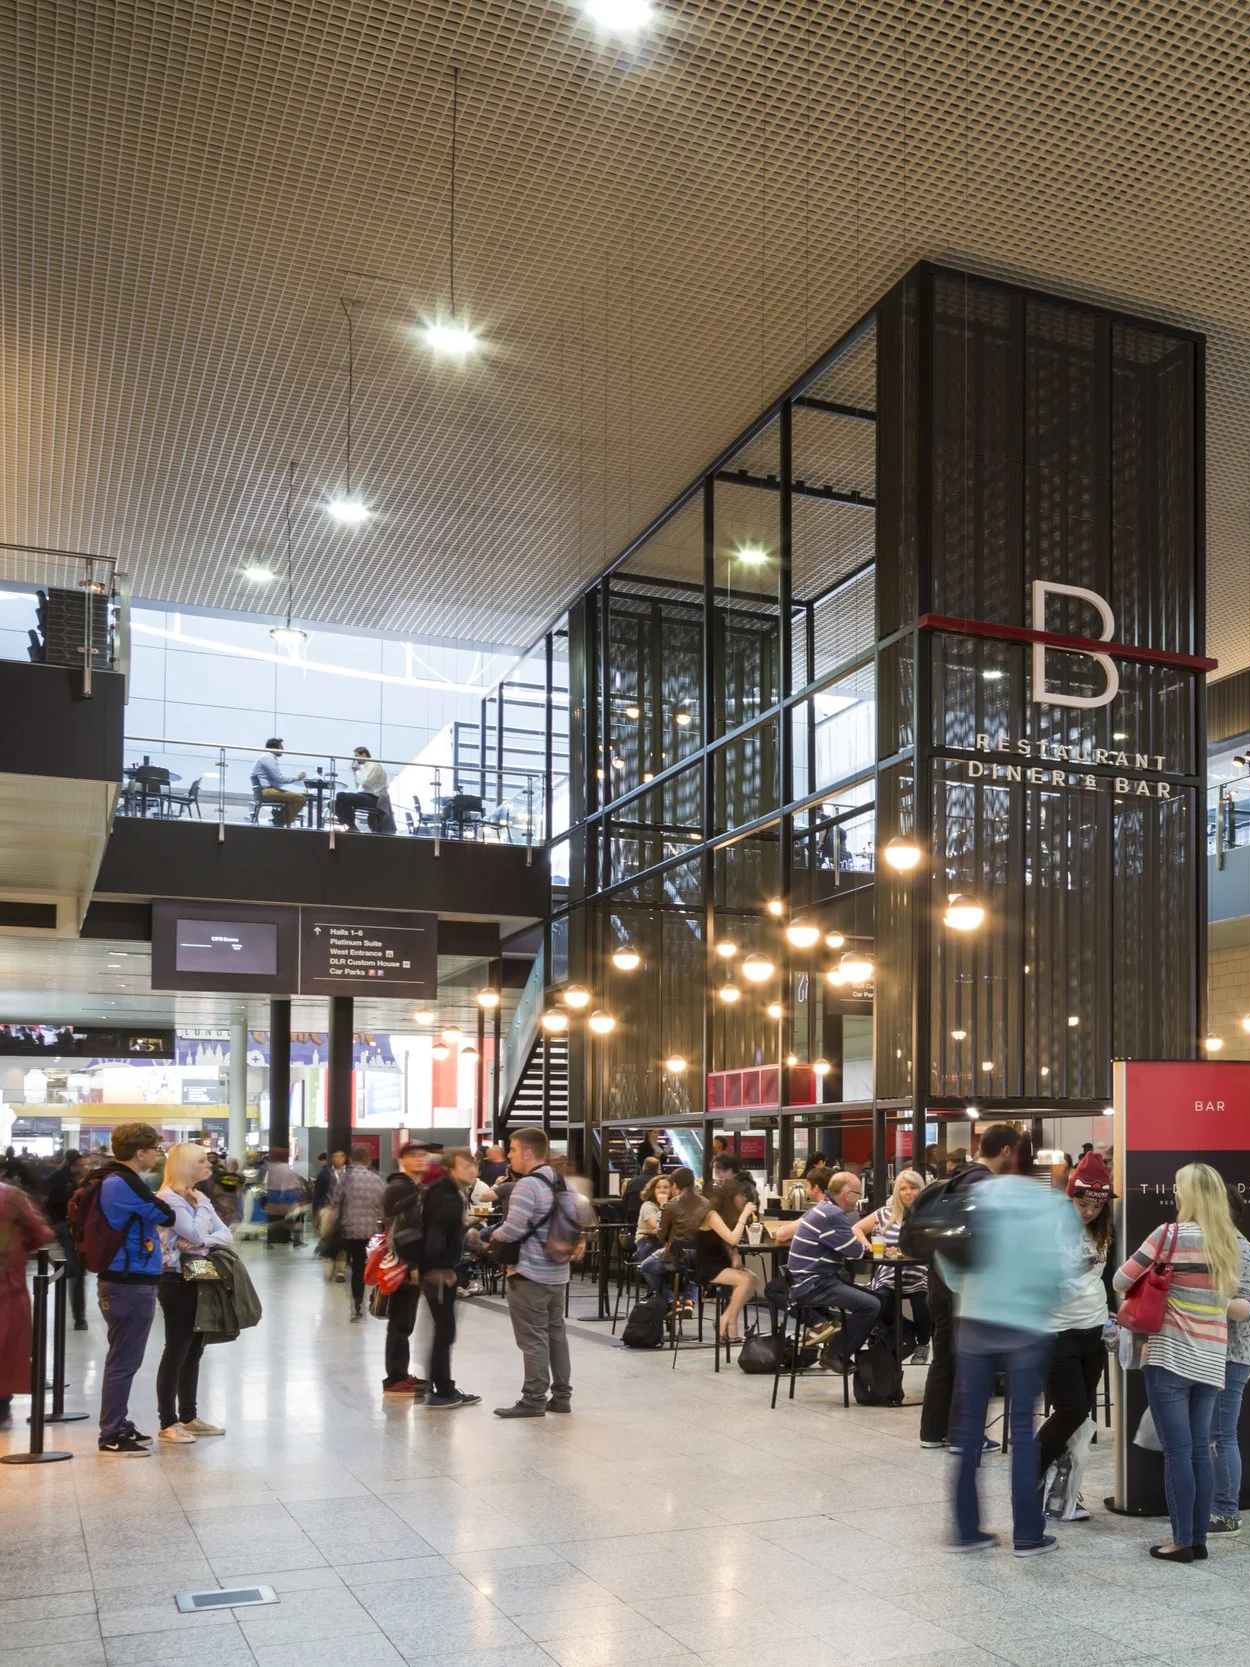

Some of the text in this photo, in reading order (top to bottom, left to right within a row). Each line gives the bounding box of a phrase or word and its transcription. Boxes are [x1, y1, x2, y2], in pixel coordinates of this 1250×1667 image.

[1032, 579, 1120, 708] B
[976, 733, 1166, 771] RESTAURANT
[968, 760, 1066, 787] DINER
[1115, 777, 1171, 799] BAR
[330, 928, 349, 936] Halls
[330, 938, 362, 946] Platinum
[349, 949, 383, 957] Entrance
[344, 968, 365, 976] Parks
[1194, 1100, 1226, 1112] BAR
